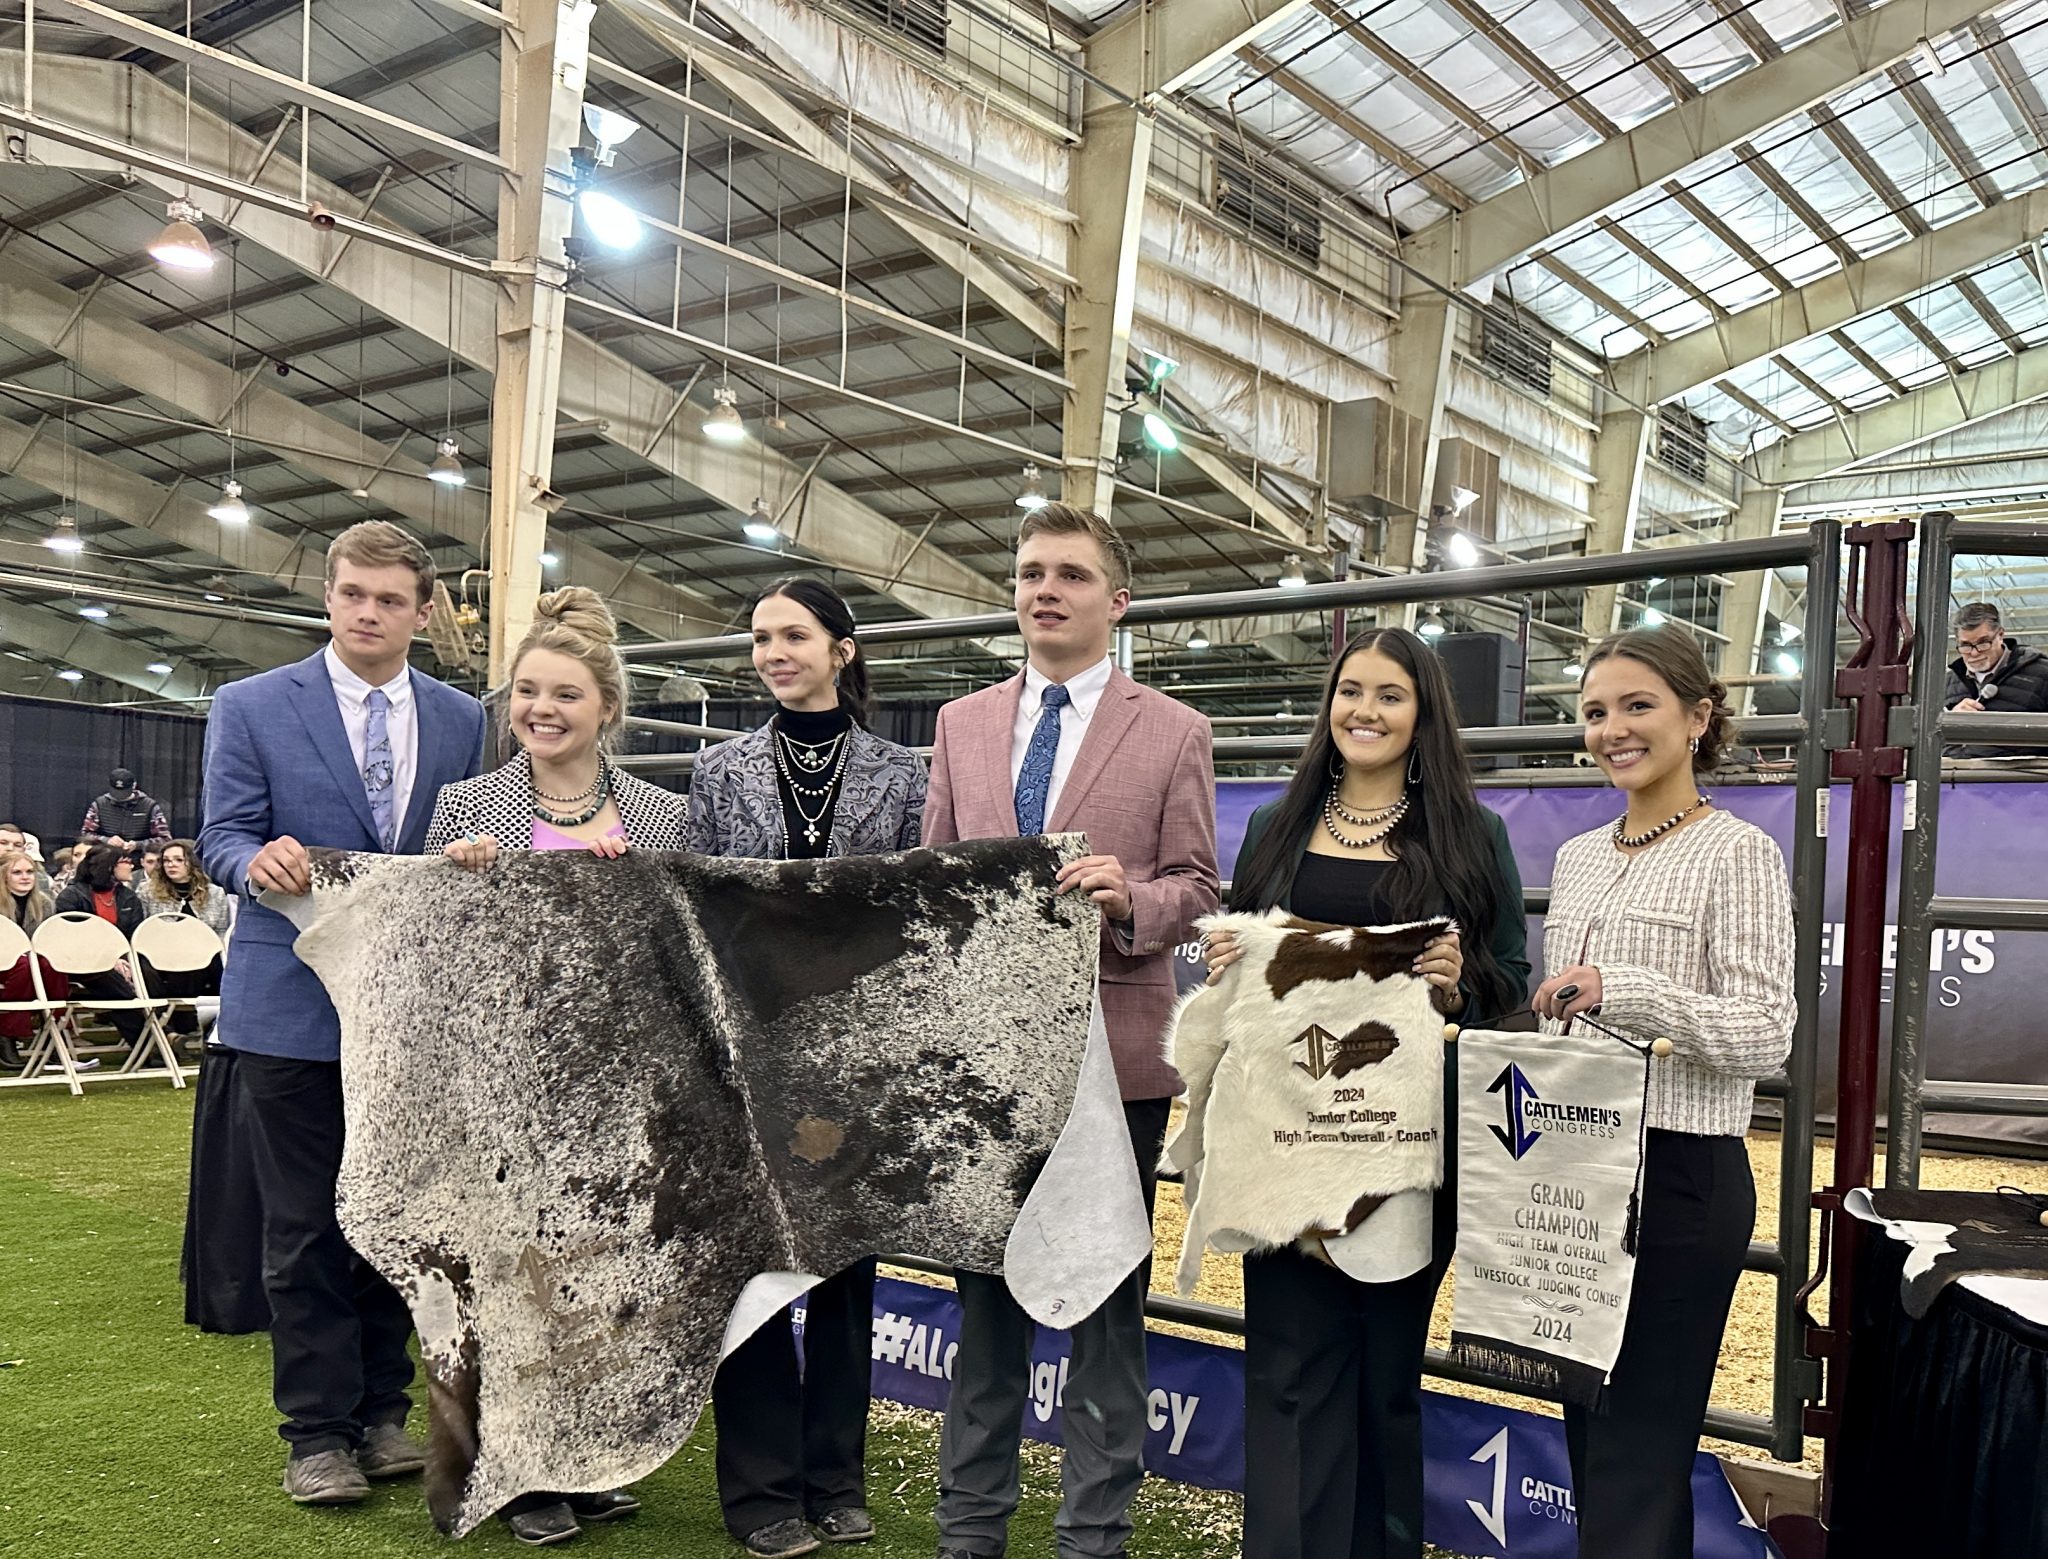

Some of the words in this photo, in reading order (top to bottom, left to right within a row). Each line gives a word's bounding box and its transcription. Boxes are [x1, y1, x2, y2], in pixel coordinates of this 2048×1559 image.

[1334, 1088, 1365, 1103] 2024
[1307, 1111, 1346, 1124] Junior
[1350, 1110, 1397, 1125] College
[1524, 1100, 1622, 1128] CATTLEMEN'S
[1273, 1130, 1301, 1146] High
[1305, 1131, 1338, 1143] Team
[1340, 1131, 1385, 1143] Overall
[1396, 1128, 1438, 1142] Coach
[1531, 1118, 1615, 1140] CONGRESS
[1530, 1182, 1585, 1211] GRAND
[1514, 1207, 1599, 1243] CHAMPION
[1496, 1232, 1524, 1249] HIGH
[1530, 1237, 1558, 1254] TEAM
[1564, 1244, 1608, 1264] OVERALL
[1474, 1265, 1531, 1288] LIVESTOCK
[1537, 1277, 1581, 1298] JUDGING
[1509, 1254, 1550, 1272] JUNIOR
[1555, 1261, 1598, 1282] COLLEGE
[1532, 1315, 1572, 1343] 2024
